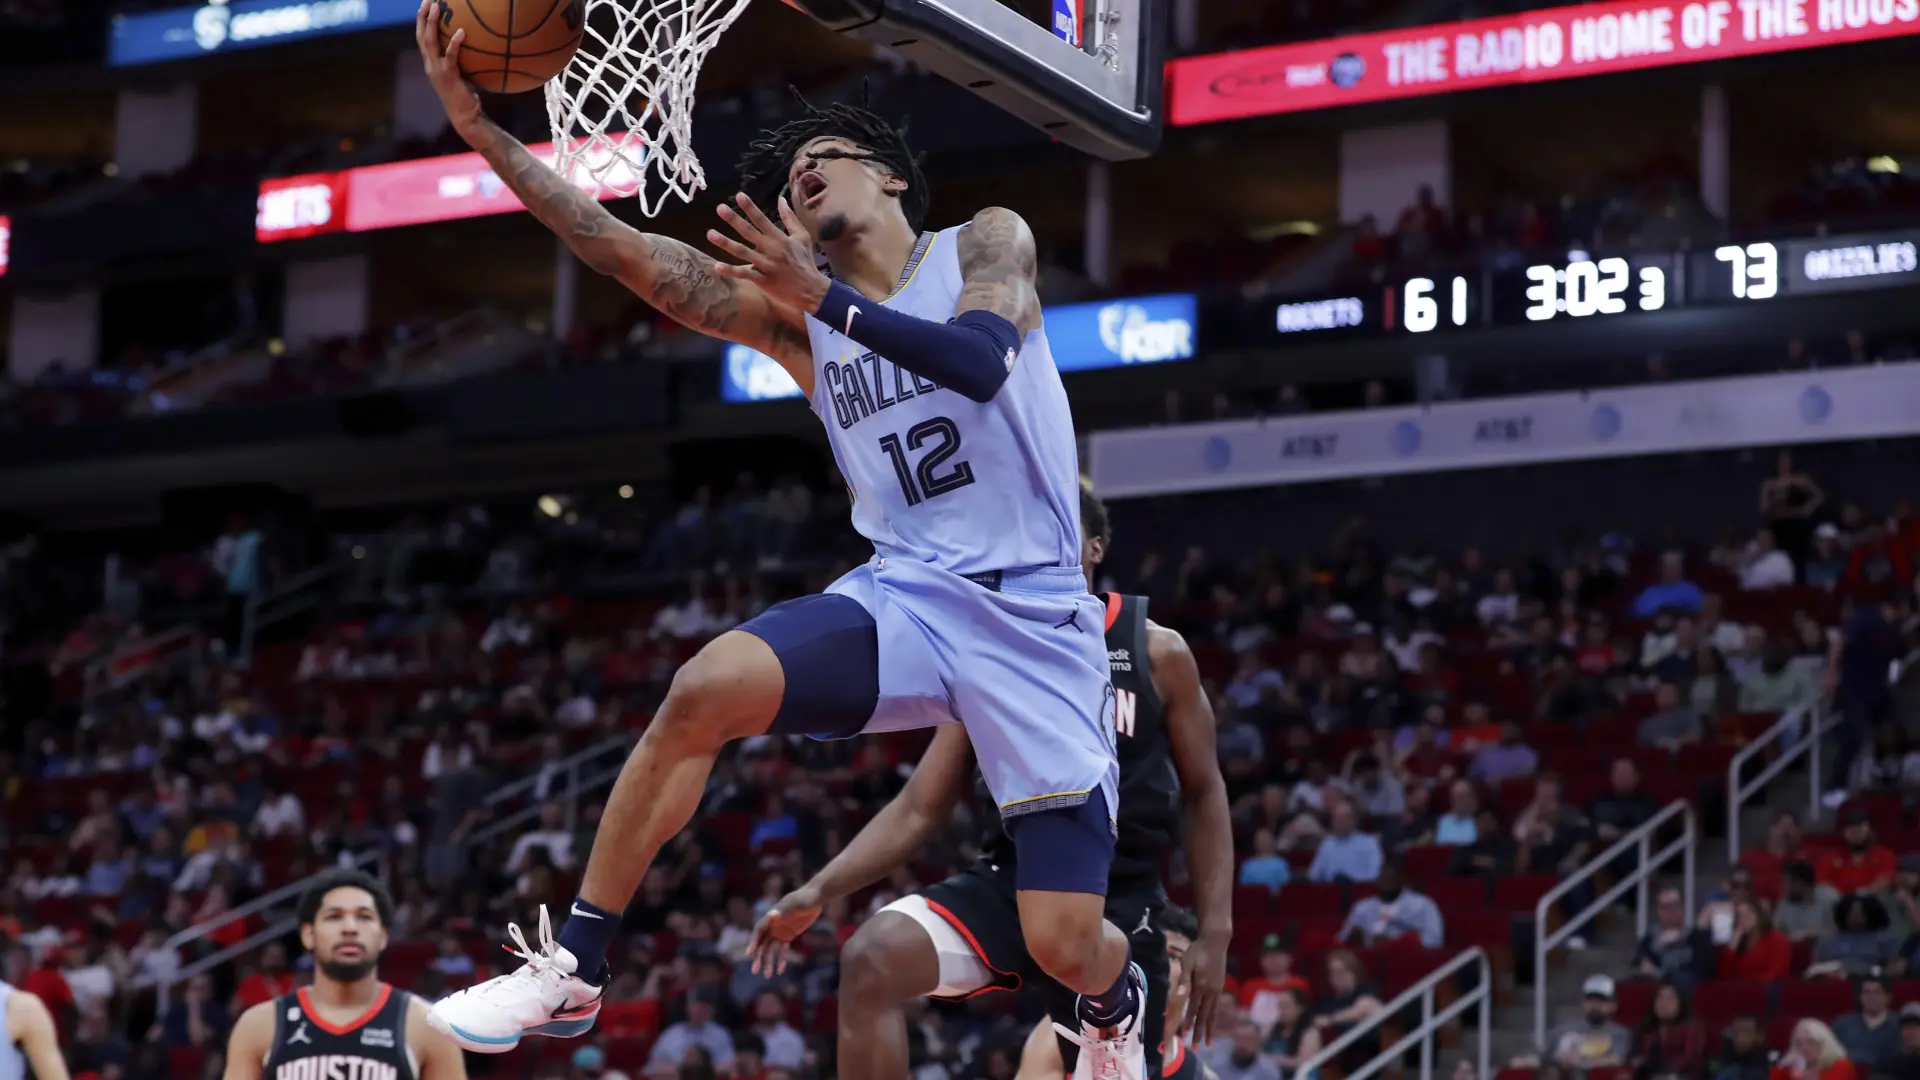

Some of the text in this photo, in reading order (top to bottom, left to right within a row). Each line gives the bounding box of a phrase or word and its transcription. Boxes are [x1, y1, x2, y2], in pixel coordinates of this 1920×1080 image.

[1384, 38, 1448, 86] THE
[1455, 22, 1562, 78] RADIO
[1571, 7, 1674, 63] HOME
[1681, 1, 1731, 49] OF
[1738, 0, 1808, 41] THE
[1526, 257, 1665, 321] 3:02 3
[1715, 242, 1778, 299] 73
[1404, 276, 1467, 333] 61
[878, 416, 975, 507] 12
